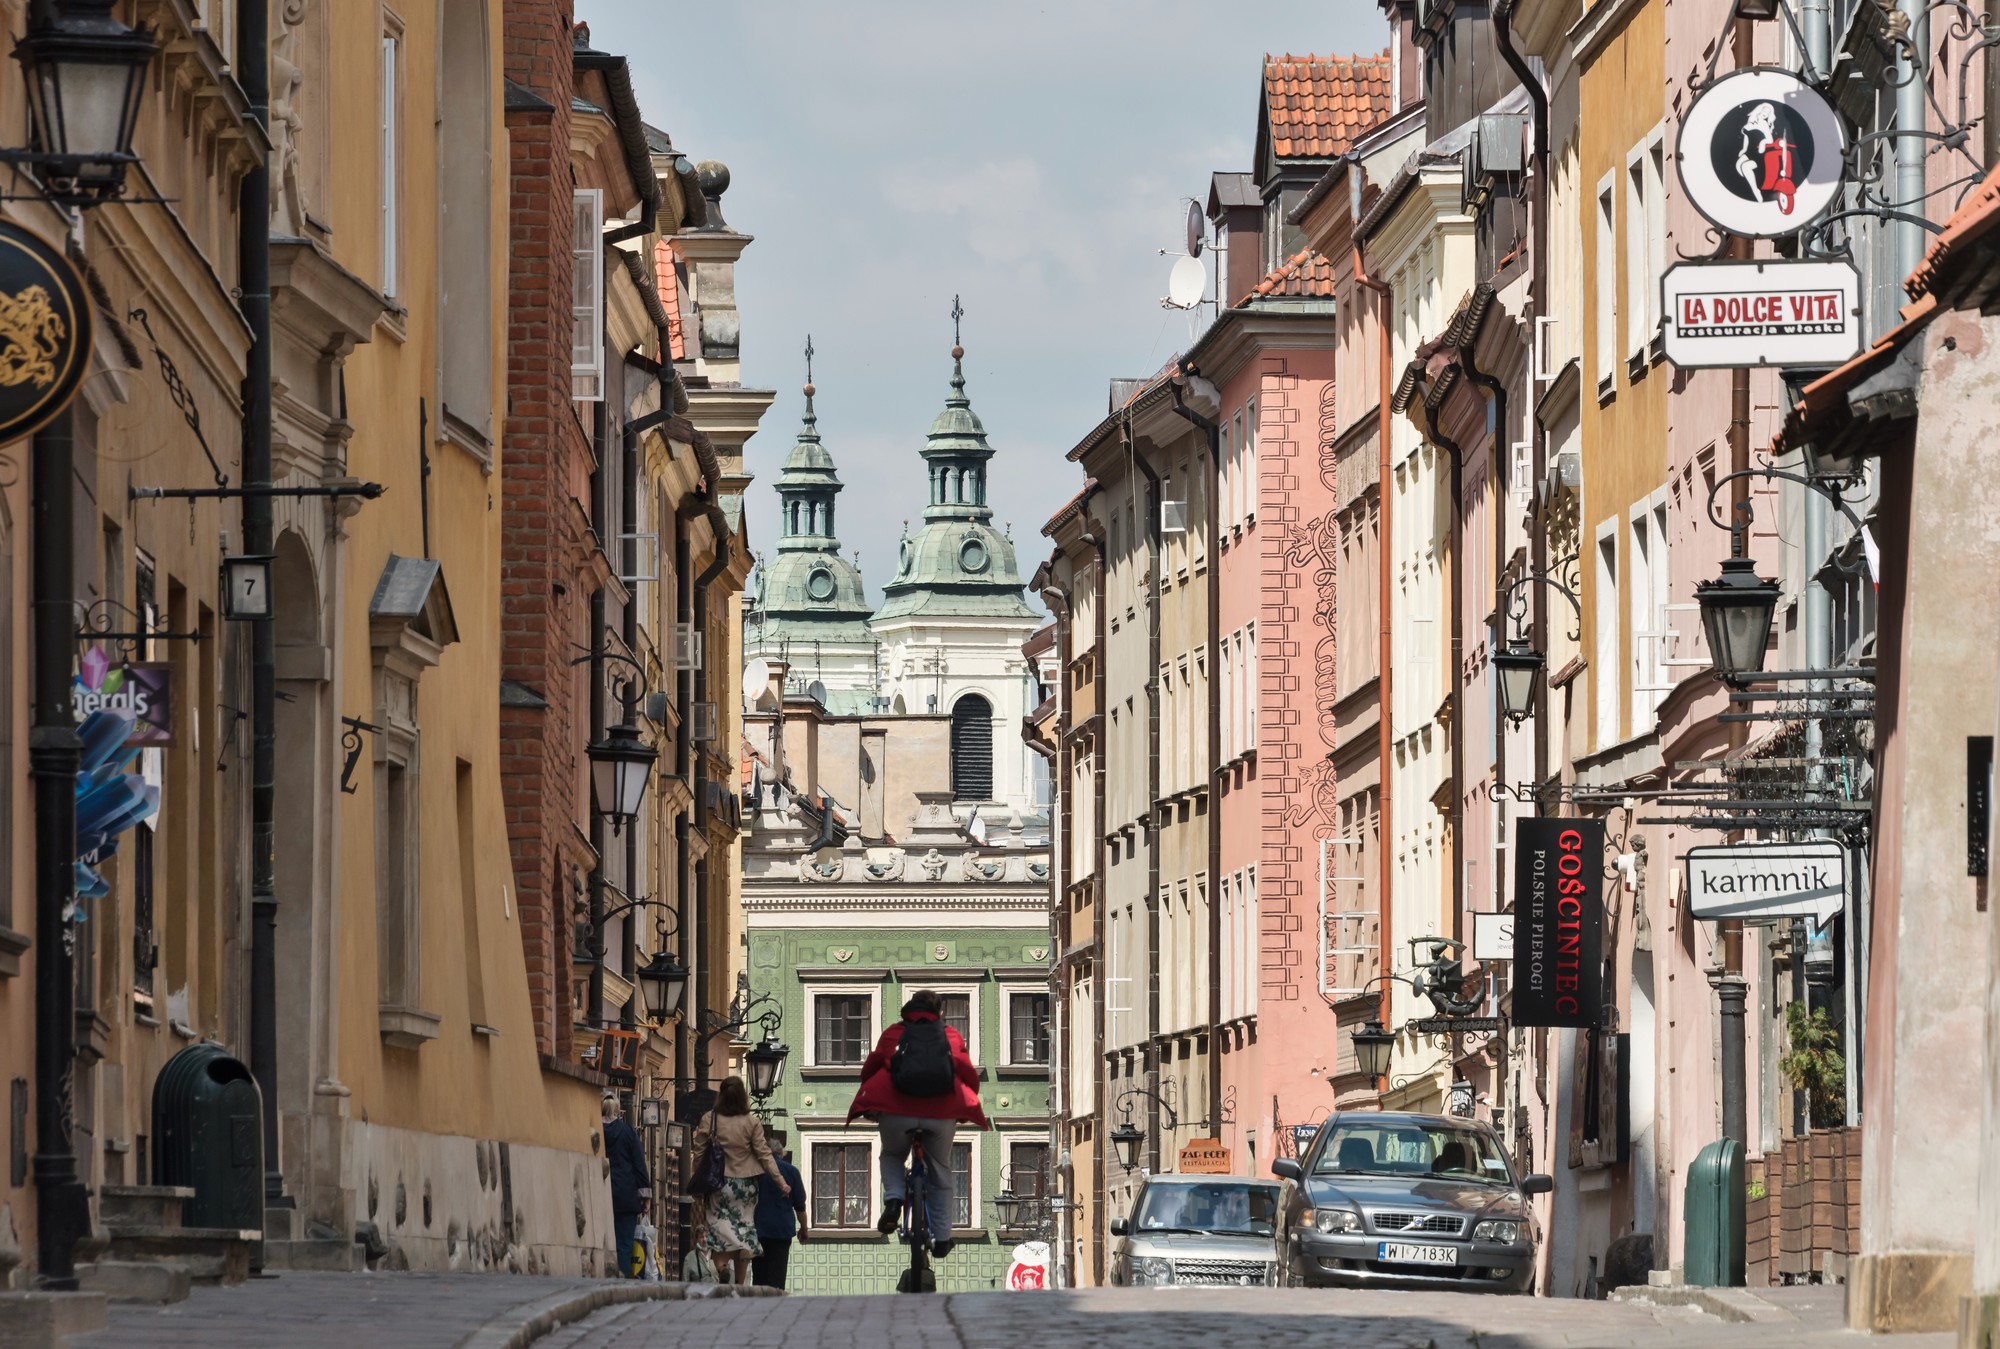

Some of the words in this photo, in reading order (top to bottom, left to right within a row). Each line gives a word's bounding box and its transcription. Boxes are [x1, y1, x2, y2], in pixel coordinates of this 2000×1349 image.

[1684, 298, 1707, 325] LA
[1713, 296, 1782, 324] DOLCE
[1789, 294, 1838, 321] VITA
[1679, 326, 1778, 336] restauracja
[1784, 323, 1843, 333] włoska
[244, 579, 256, 596] 7
[1532, 849, 1546, 918] POLSKIE
[1700, 865, 1830, 894] karmnik
[1499, 923, 1514, 942] S
[1555, 829, 1586, 1015] GOŚCINIEC
[1530, 924, 1544, 991] PIEROGI
[1388, 1244, 1405, 1259] WI
[1412, 1246, 1455, 1263] 7183K
